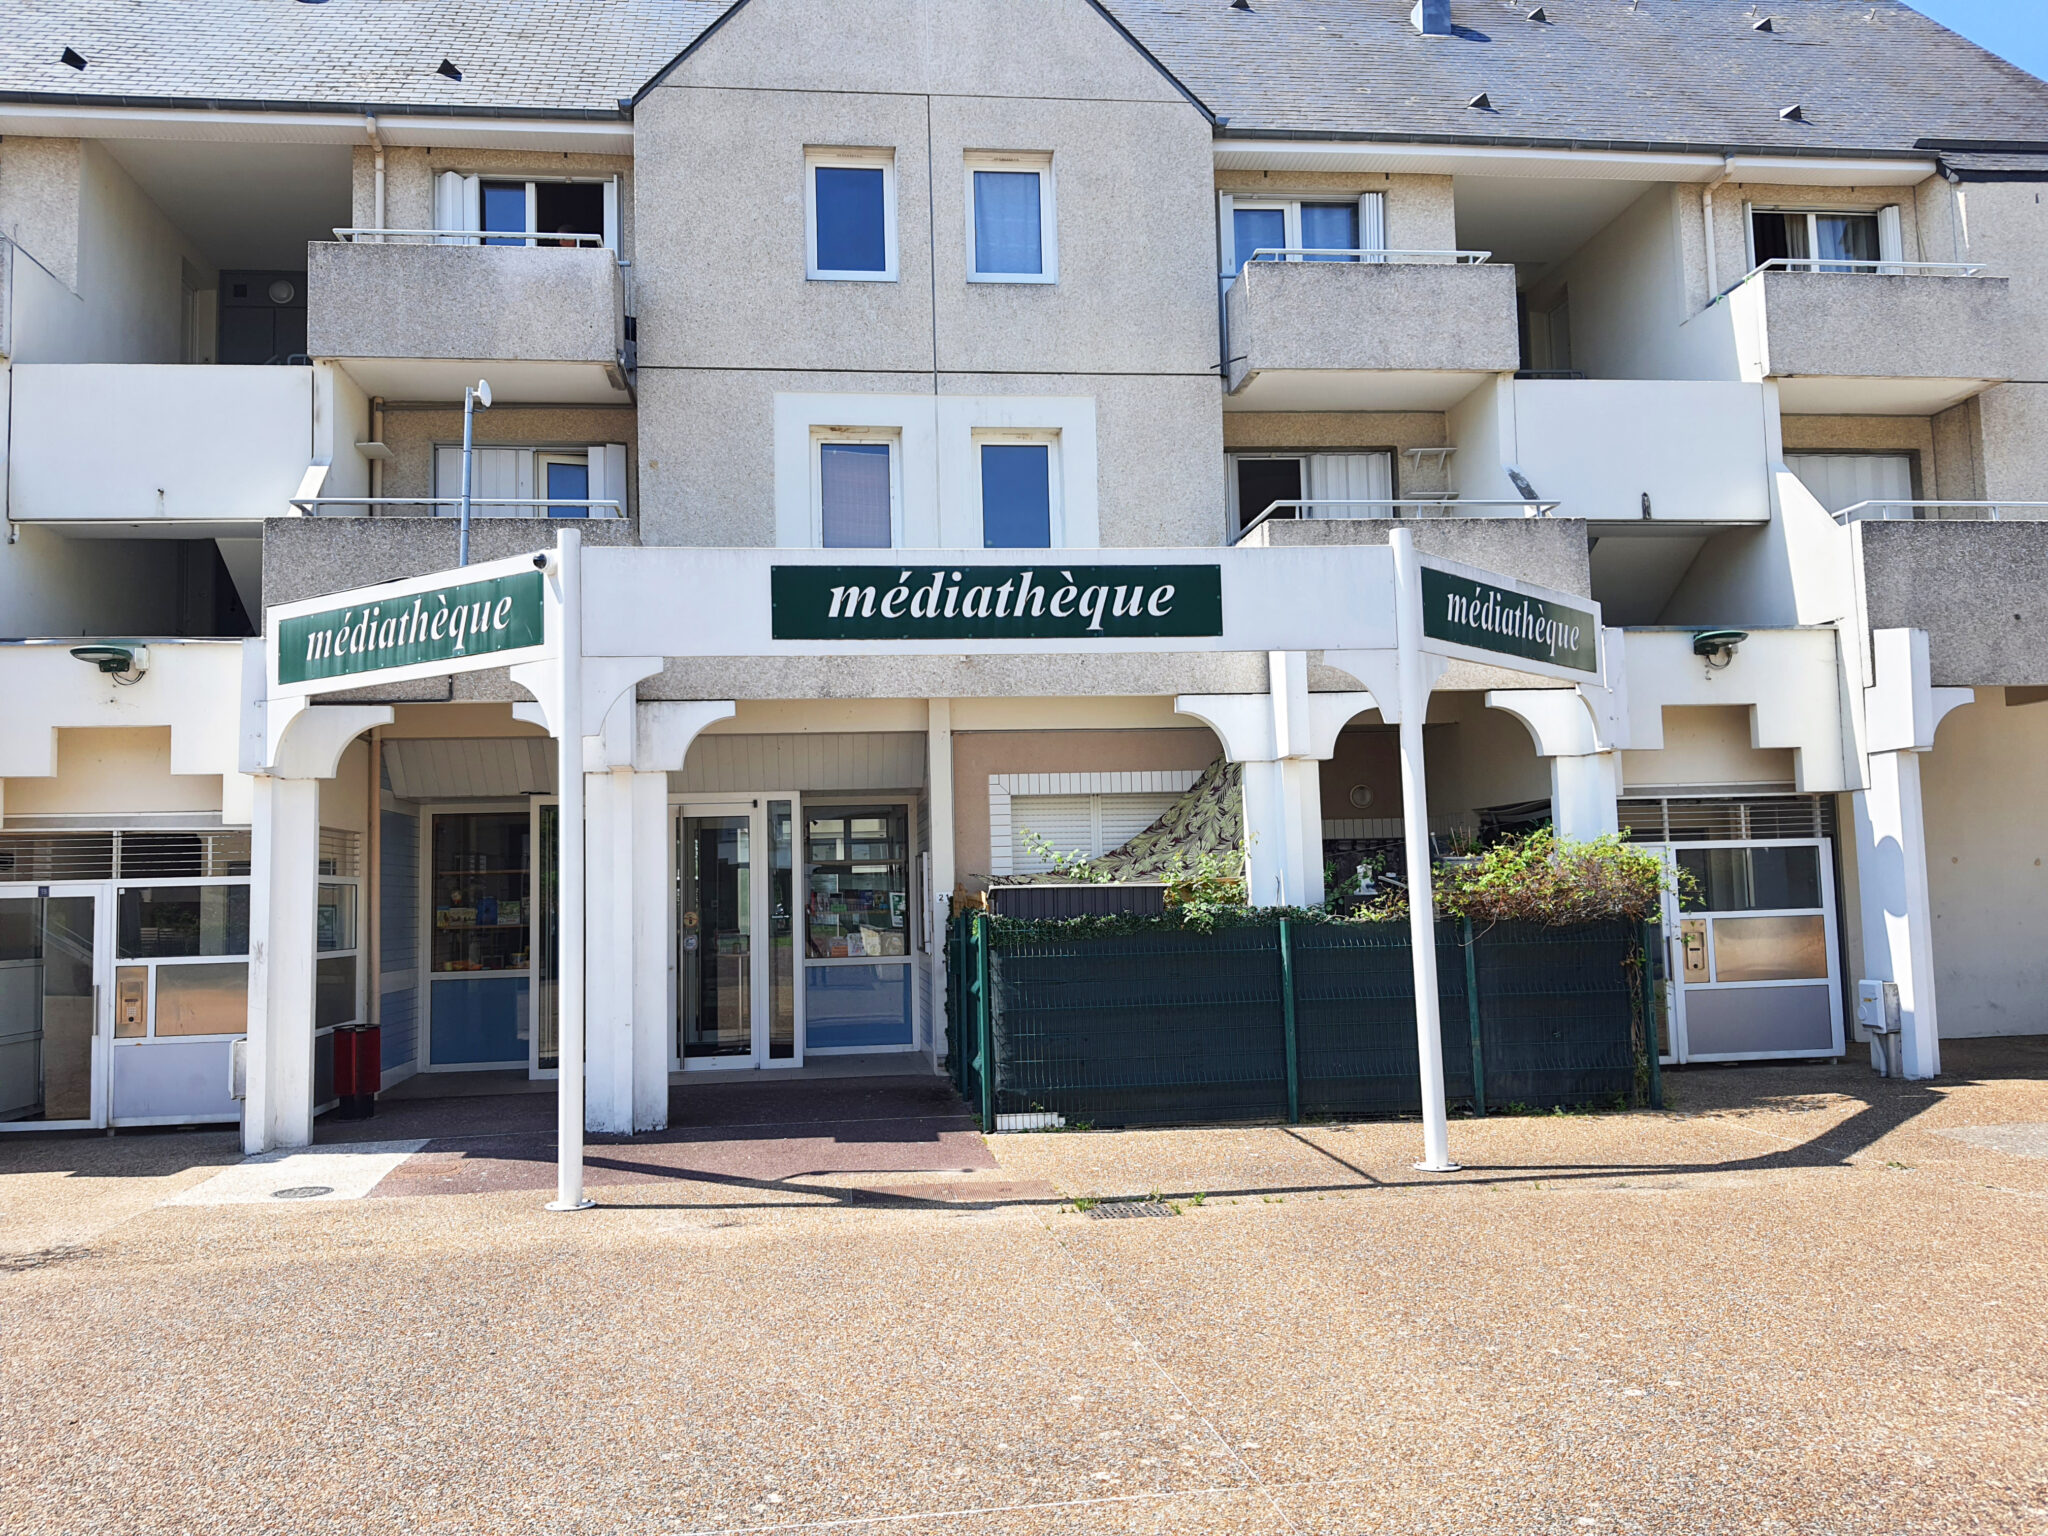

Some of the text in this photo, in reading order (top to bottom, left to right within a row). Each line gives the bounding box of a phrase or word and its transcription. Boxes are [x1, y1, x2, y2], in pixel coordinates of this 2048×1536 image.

[306, 594, 513, 650] médiathèque
[827, 570, 1175, 631] médiathèque
[1447, 587, 1580, 657] médiathèque
